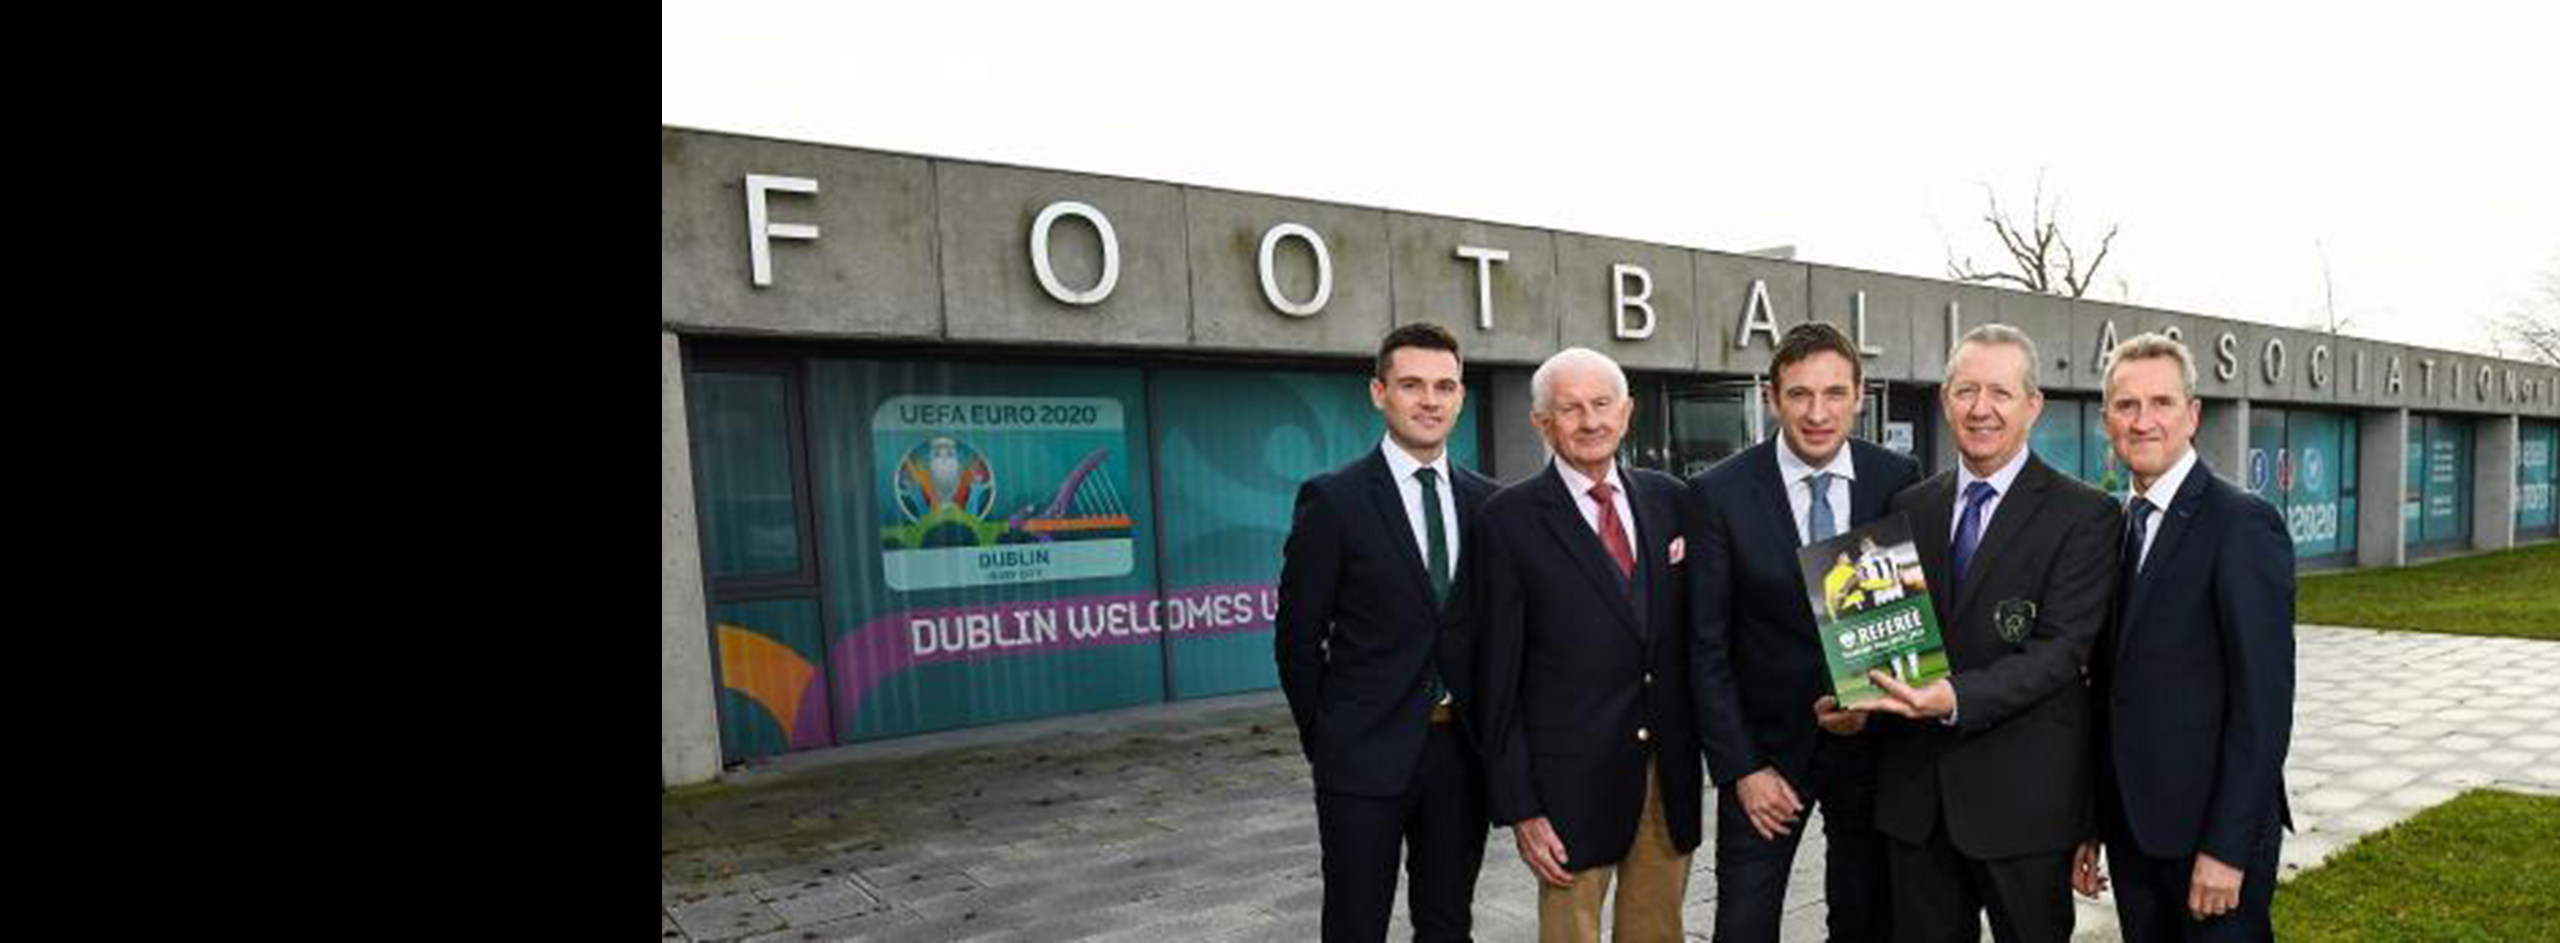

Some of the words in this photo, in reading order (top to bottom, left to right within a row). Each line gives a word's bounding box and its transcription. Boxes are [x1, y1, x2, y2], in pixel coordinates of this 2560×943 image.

[901, 405, 968, 425] UEFA
[970, 405, 1036, 425] EURO
[1040, 405, 1098, 426] 2020
[979, 549, 1051, 569] DUBLIN
[911, 609, 1057, 655] DUBLIN
[1067, 593, 1253, 640] WELCOMES
[1261, 590, 1279, 620] U
[1858, 608, 1922, 644] REFEREE
